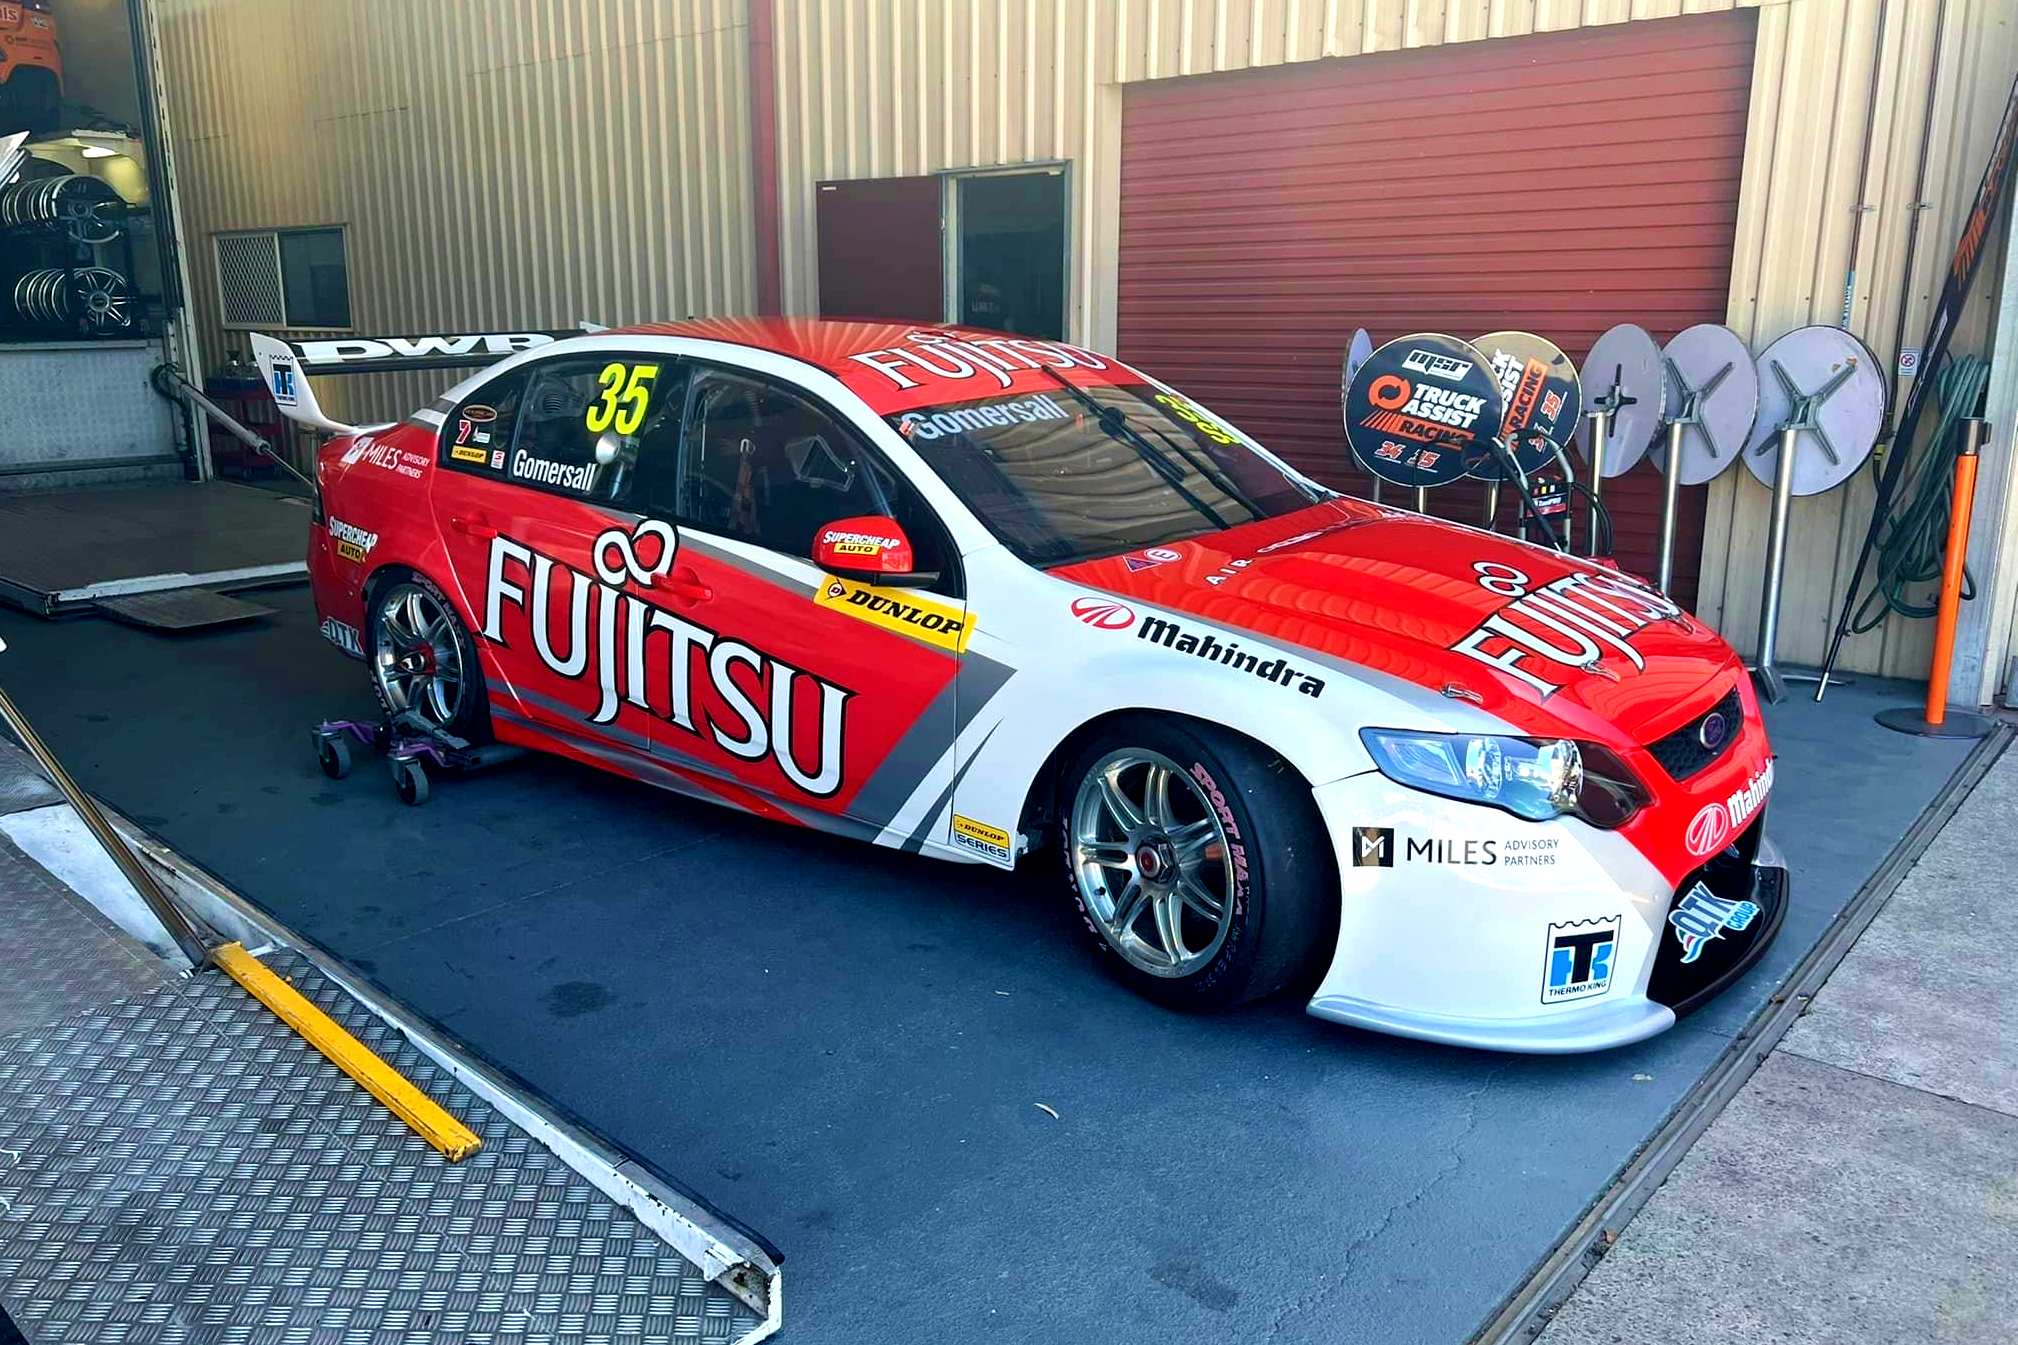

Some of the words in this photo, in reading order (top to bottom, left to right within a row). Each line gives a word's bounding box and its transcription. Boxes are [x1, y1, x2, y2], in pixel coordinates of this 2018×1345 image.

[301, 333, 555, 363] DWR
[848, 339, 1108, 391] FUJITSU
[1502, 355, 1524, 412] SIST
[1509, 363, 1542, 429] RACING
[586, 363, 658, 434] 35
[1413, 383, 1487, 414] TRUCK
[1540, 389, 1562, 422] 35
[901, 395, 1069, 440] Gomersall
[1401, 400, 1479, 429] ASSIST
[1399, 420, 1470, 442] RACI
[362, 442, 402, 470] MILES
[401, 452, 431, 467] ADVISORY
[458, 449, 484, 459] DUNLOP
[1407, 448, 1440, 468] 5
[395, 464, 423, 479] PARTNERS
[513, 449, 596, 491] Gomersall
[328, 516, 378, 553] SUPERCHEAP
[823, 531, 900, 549] SUPERCHEAP
[839, 545, 873, 553] AUTO
[340, 543, 362, 559] AUTO
[1205, 558, 1252, 585] AIR
[846, 589, 965, 634] DUNLOP
[1449, 572, 1681, 702] FUJITSU
[482, 535, 856, 797] FUJITSU
[1137, 616, 1326, 699] Mahindra
[1190, 763, 1240, 839] SPORT
[957, 834, 1007, 857] SERIES
[964, 825, 1004, 840] DUNLOP
[1407, 837, 1497, 865] MILES
[1505, 838, 1559, 851] ADVISORY
[1505, 854, 1556, 866] PARTNERS
[1726, 902, 1758, 929] GROUP
[1549, 984, 1585, 996] THERMO
[1587, 980, 1606, 990] KING
